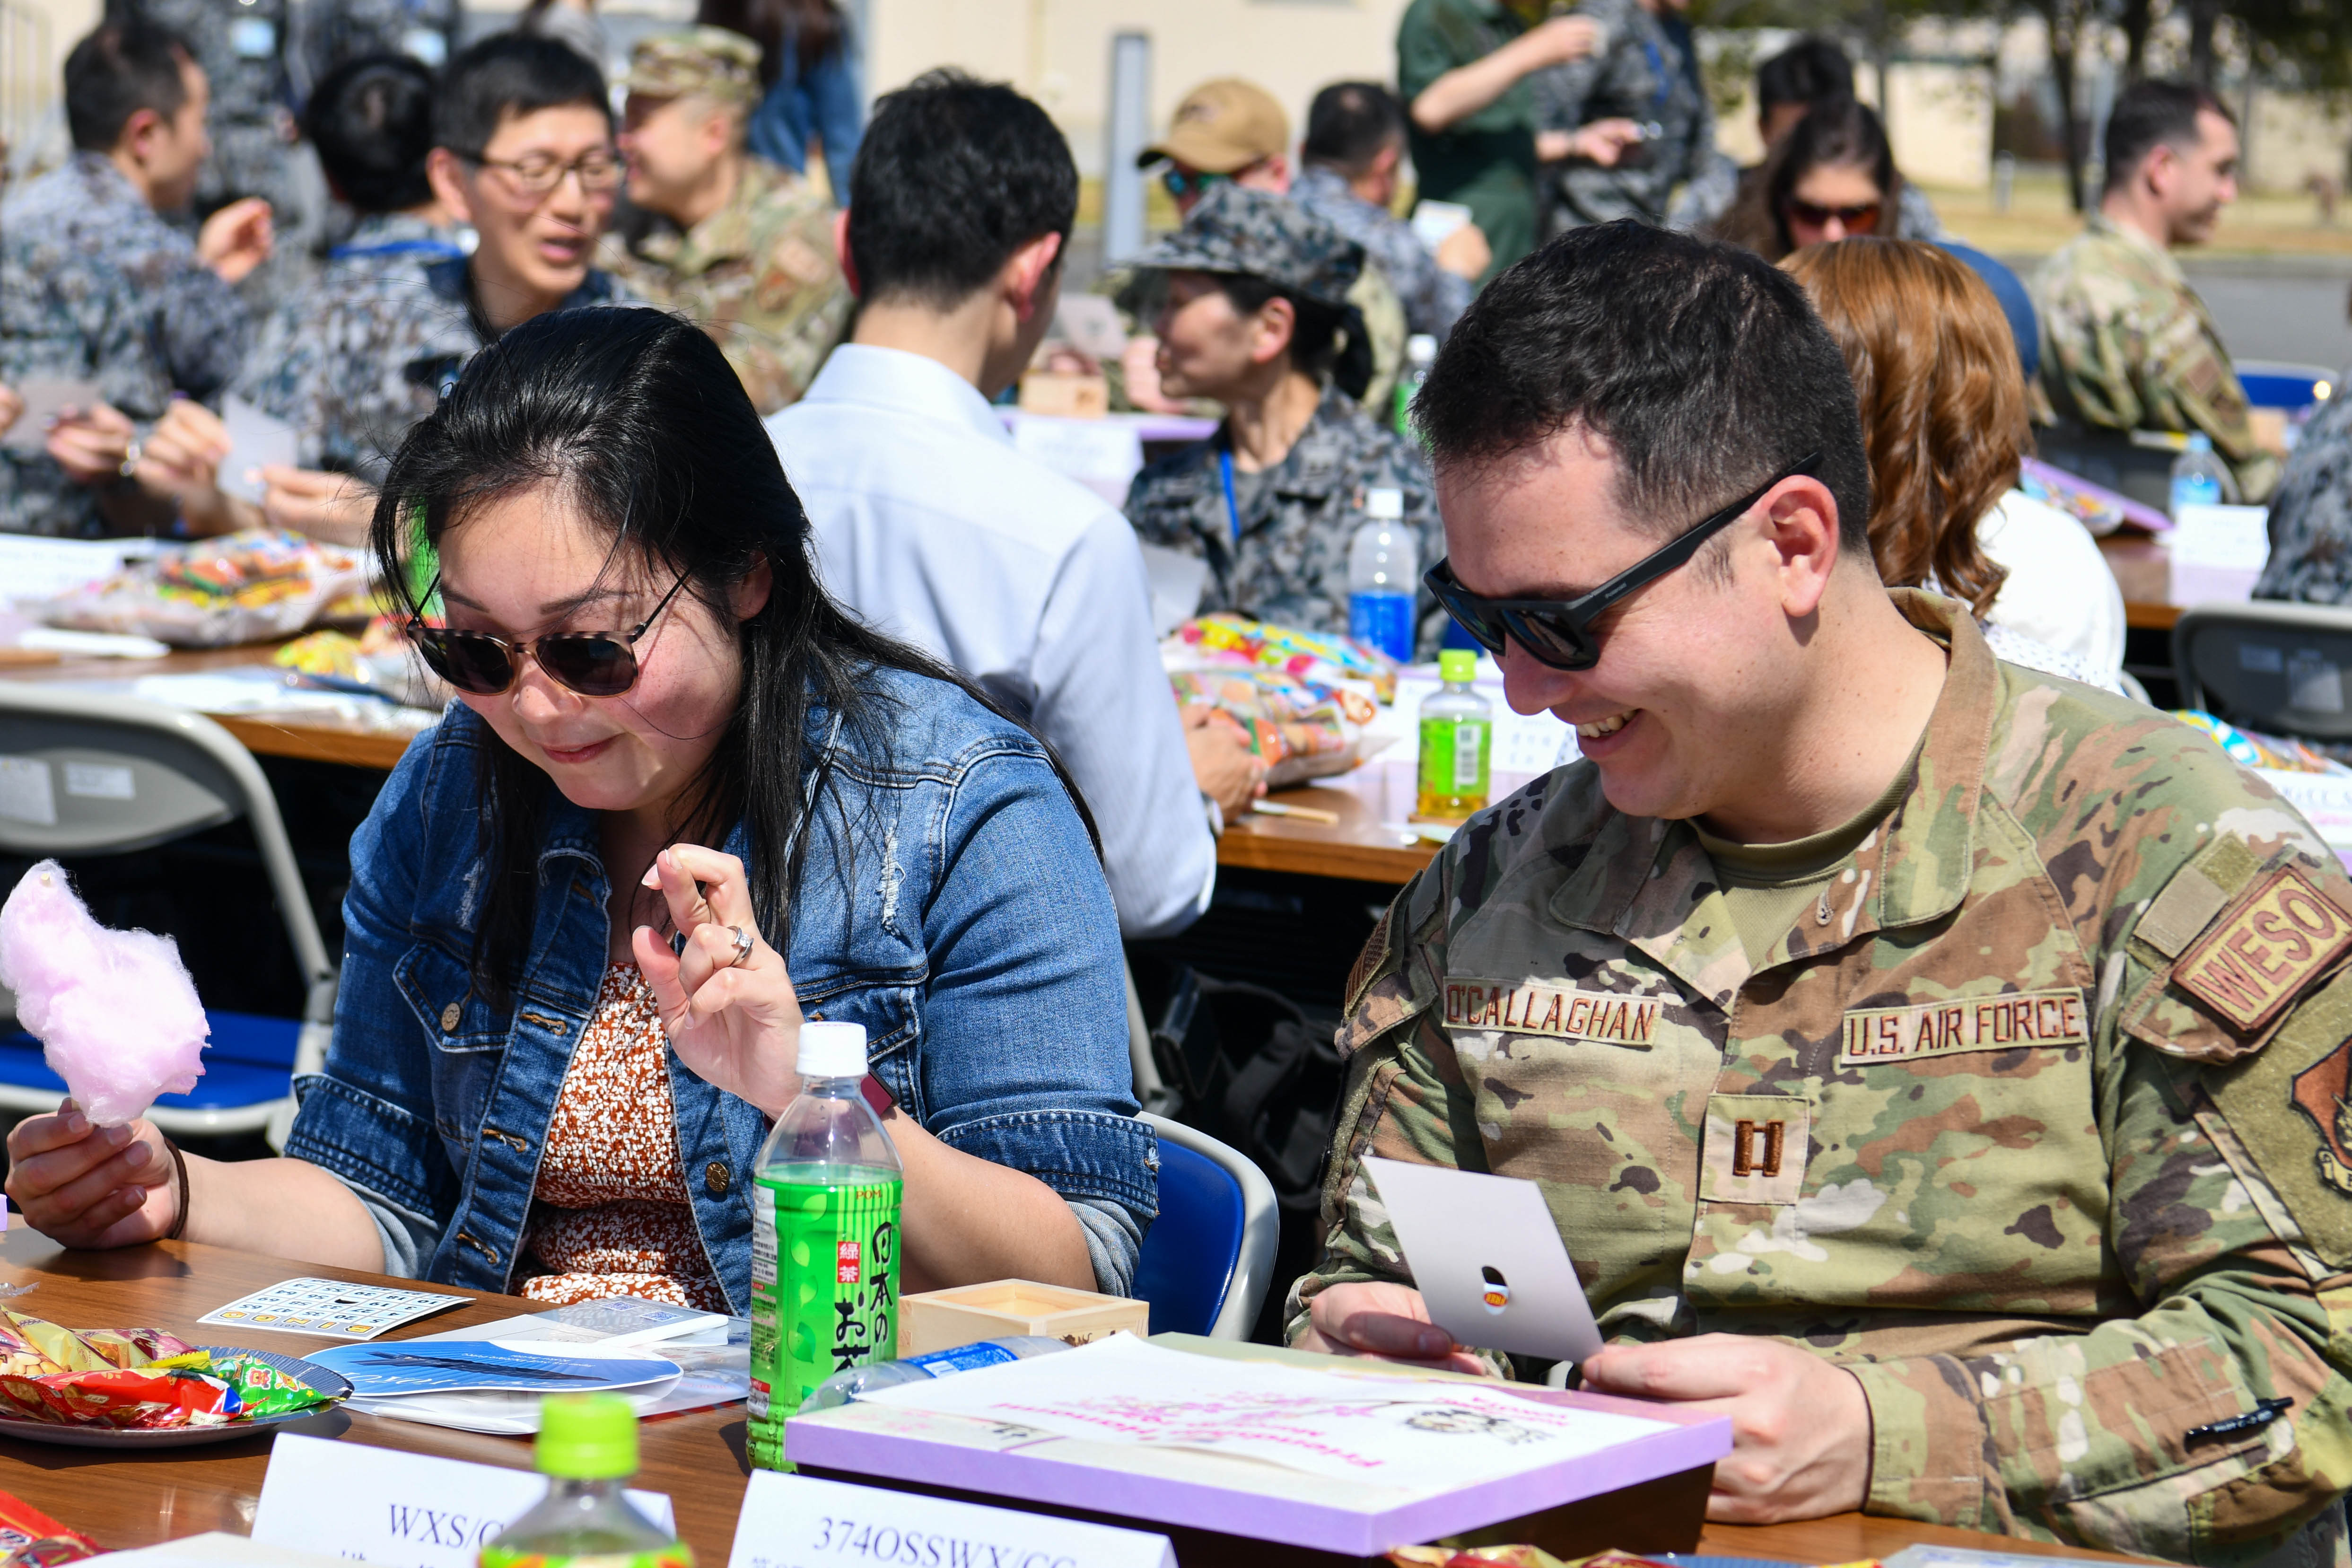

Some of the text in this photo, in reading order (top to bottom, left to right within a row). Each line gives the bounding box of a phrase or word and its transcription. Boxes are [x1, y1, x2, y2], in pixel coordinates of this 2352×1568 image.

[2193, 888, 2336, 1013] WESO
[1446, 984, 1656, 1041] O'CALLAGHAN
[1850, 998, 2081, 1056] U.S. AIR FORCE
[839, 1244, 859, 1283] 緑茶
[870, 1221, 893, 1344] 日本の
[219, 1311, 375, 1334] BINGO
